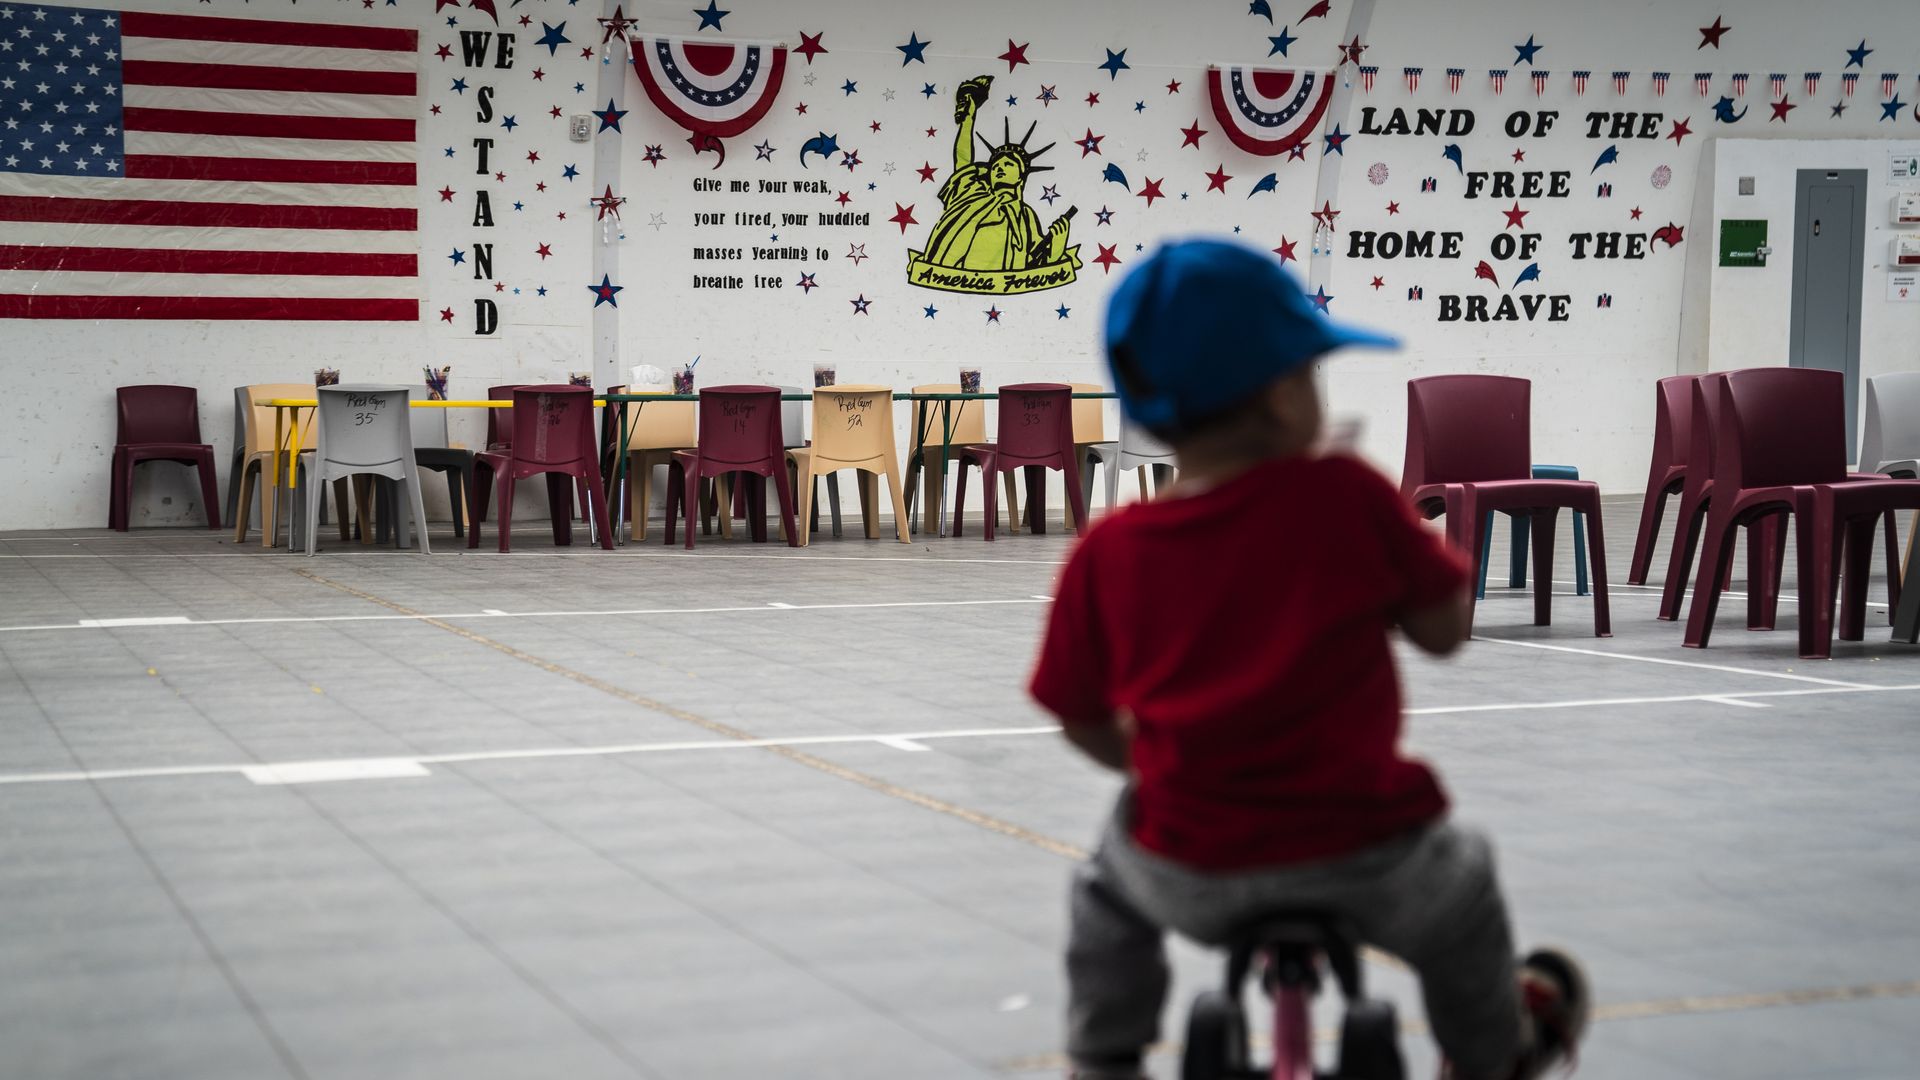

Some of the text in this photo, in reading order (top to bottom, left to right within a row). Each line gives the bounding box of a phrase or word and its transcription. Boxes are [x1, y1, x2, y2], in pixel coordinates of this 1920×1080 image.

[460, 30, 516, 69] WE
[1359, 106, 1664, 139] LAND OF THE
[693, 177, 722, 192] Give
[730, 180, 750, 193] me
[793, 179, 832, 195] weak,
[1463, 170, 1571, 200] FREE
[472, 85, 499, 336] STAND
[694, 211, 870, 229] your tired, your huddled
[693, 247, 743, 260] masses
[816, 247, 829, 261] to
[1346, 230, 1648, 261] HOME OF THE
[693, 274, 783, 289] breathe free
[918, 266, 1071, 293] America Forever
[1437, 293, 1572, 323] BRAVE
[720, 399, 738, 417] Red
[834, 394, 873, 412] Red Gym
[355, 412, 380, 426] 35
[734, 418, 746, 436] 14
[847, 414, 863, 431] 52
[1022, 412, 1041, 427] 33
